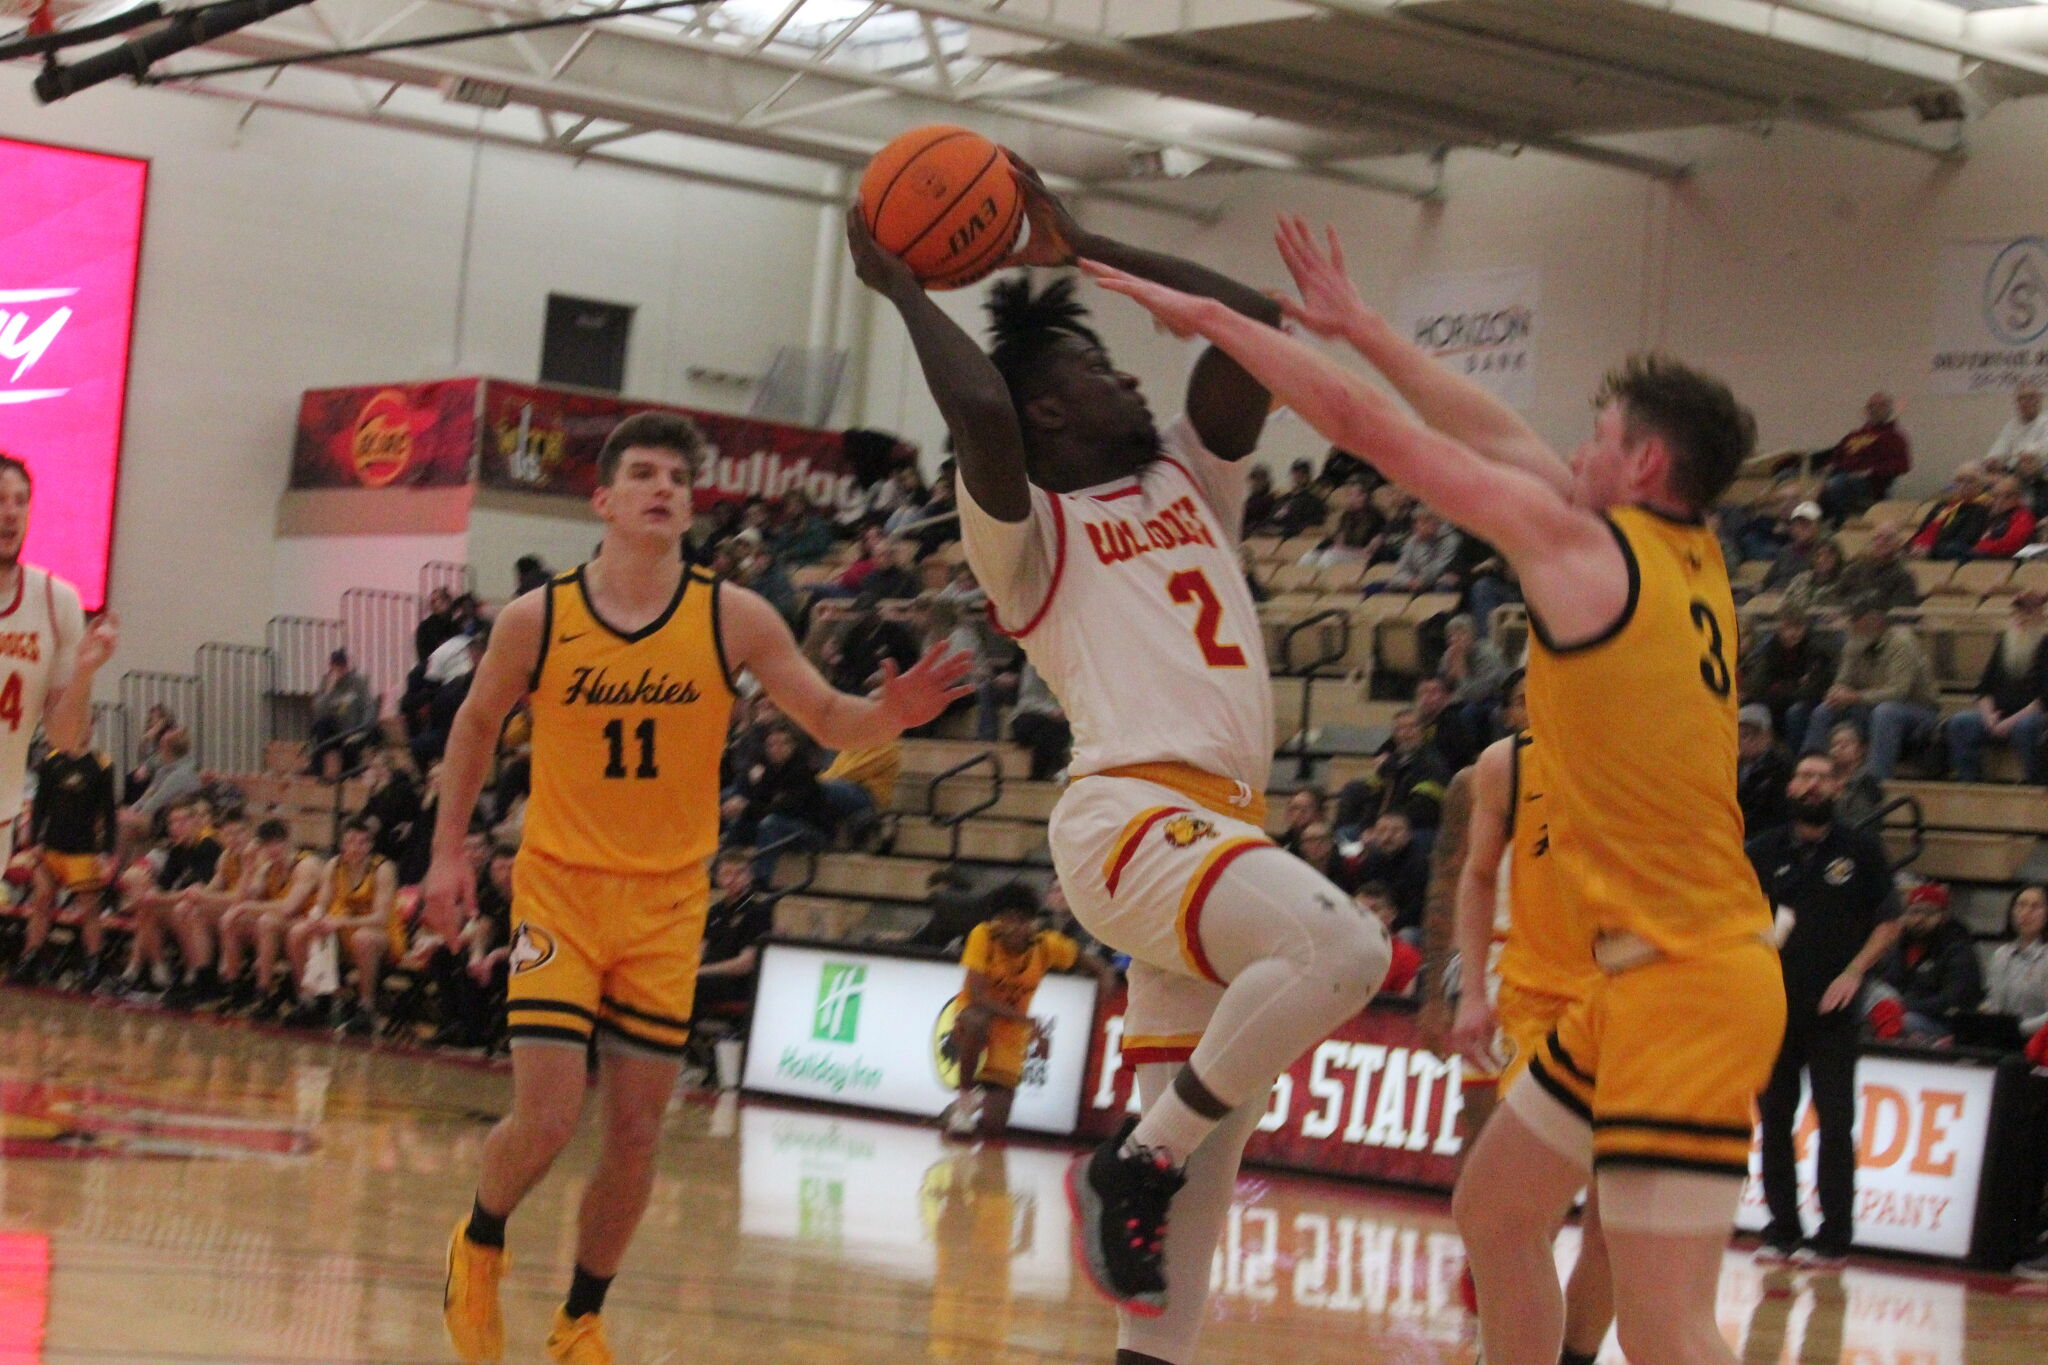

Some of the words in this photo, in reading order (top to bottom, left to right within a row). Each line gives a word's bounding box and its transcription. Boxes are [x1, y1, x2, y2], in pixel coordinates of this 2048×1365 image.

[0, 305, 73, 383] y
[1415, 310, 1532, 349] HORIZON
[1165, 565, 1248, 669] 2
[1689, 600, 1731, 698] 3
[0, 671, 23, 733] 4
[561, 666, 701, 706] Huskies
[603, 718, 660, 779] 11
[776, 1045, 848, 1093] Holiday
[1301, 1040, 1466, 1156] STATE
[1855, 1083, 1967, 1178] DE
[1853, 1188, 1952, 1231] PANY
